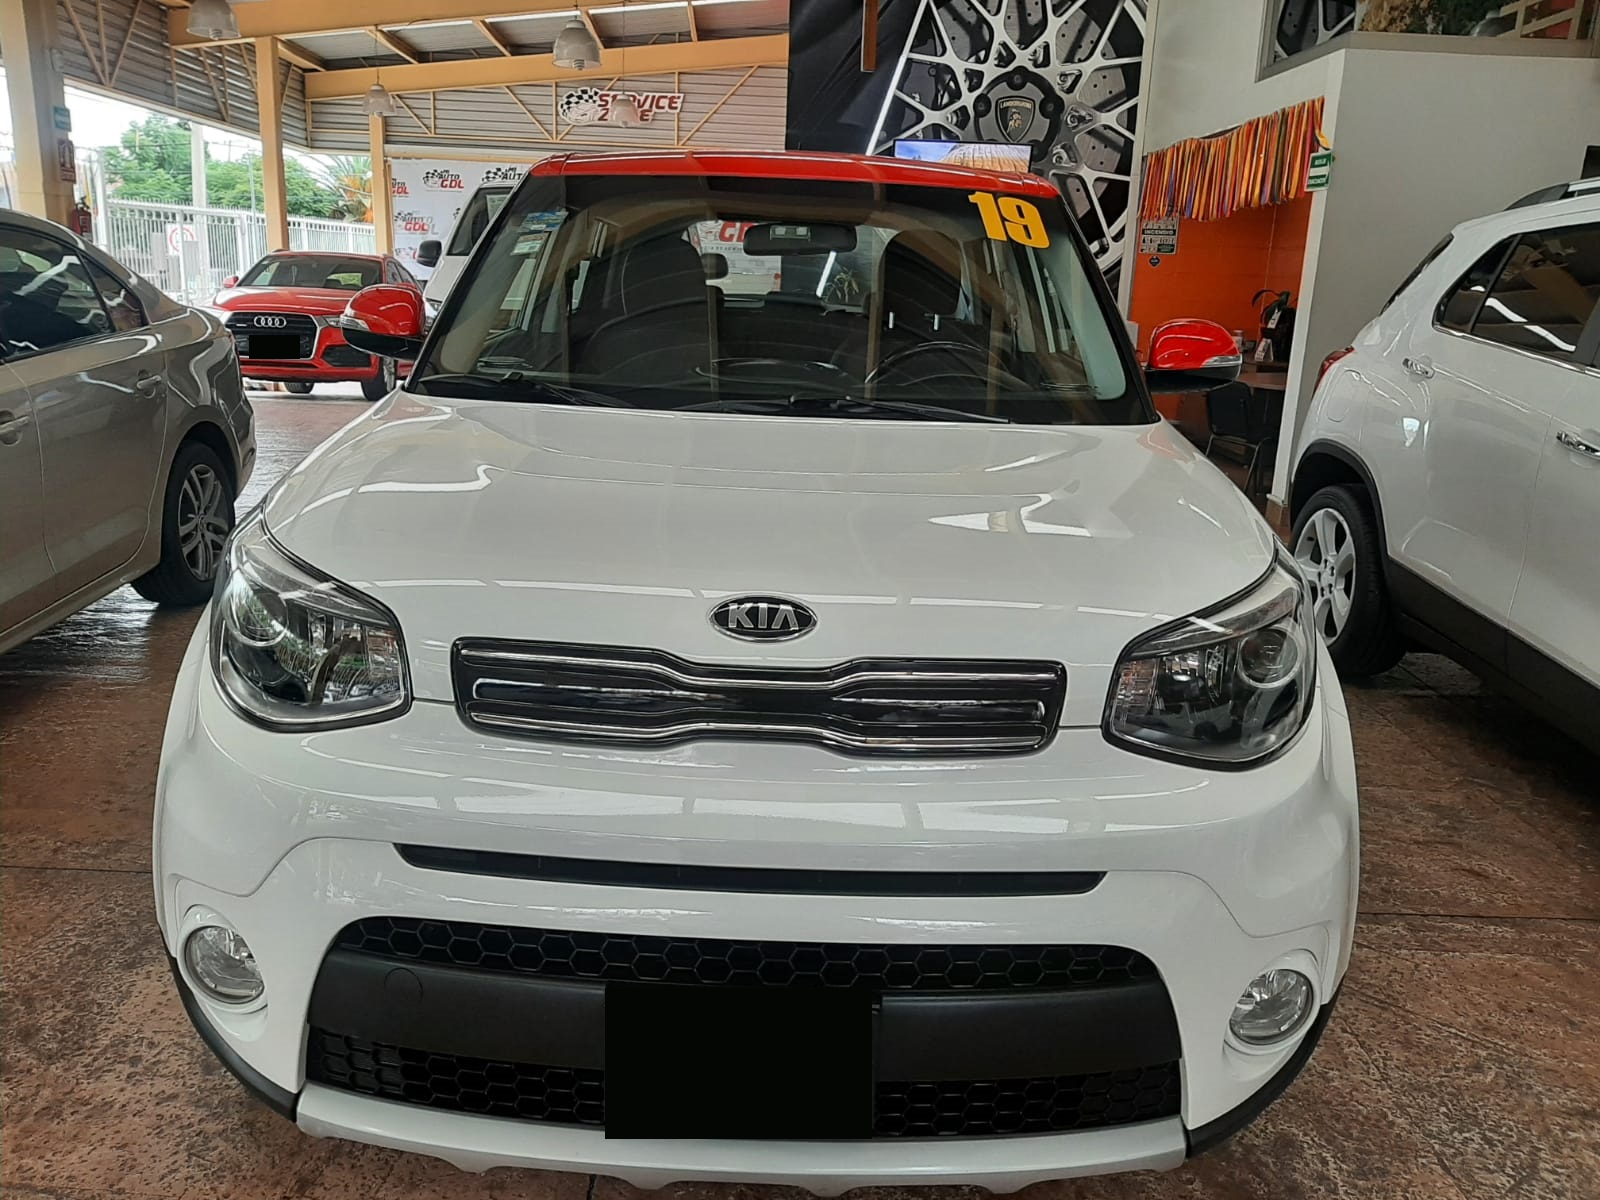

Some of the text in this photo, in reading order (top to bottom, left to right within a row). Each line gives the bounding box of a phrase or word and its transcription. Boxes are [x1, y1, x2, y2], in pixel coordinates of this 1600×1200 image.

[598, 107, 652, 121] ZE
[501, 172, 523, 181] AUT
[440, 179, 464, 189] GDL
[968, 191, 1050, 249] 19
[728, 603, 799, 630] KIA
